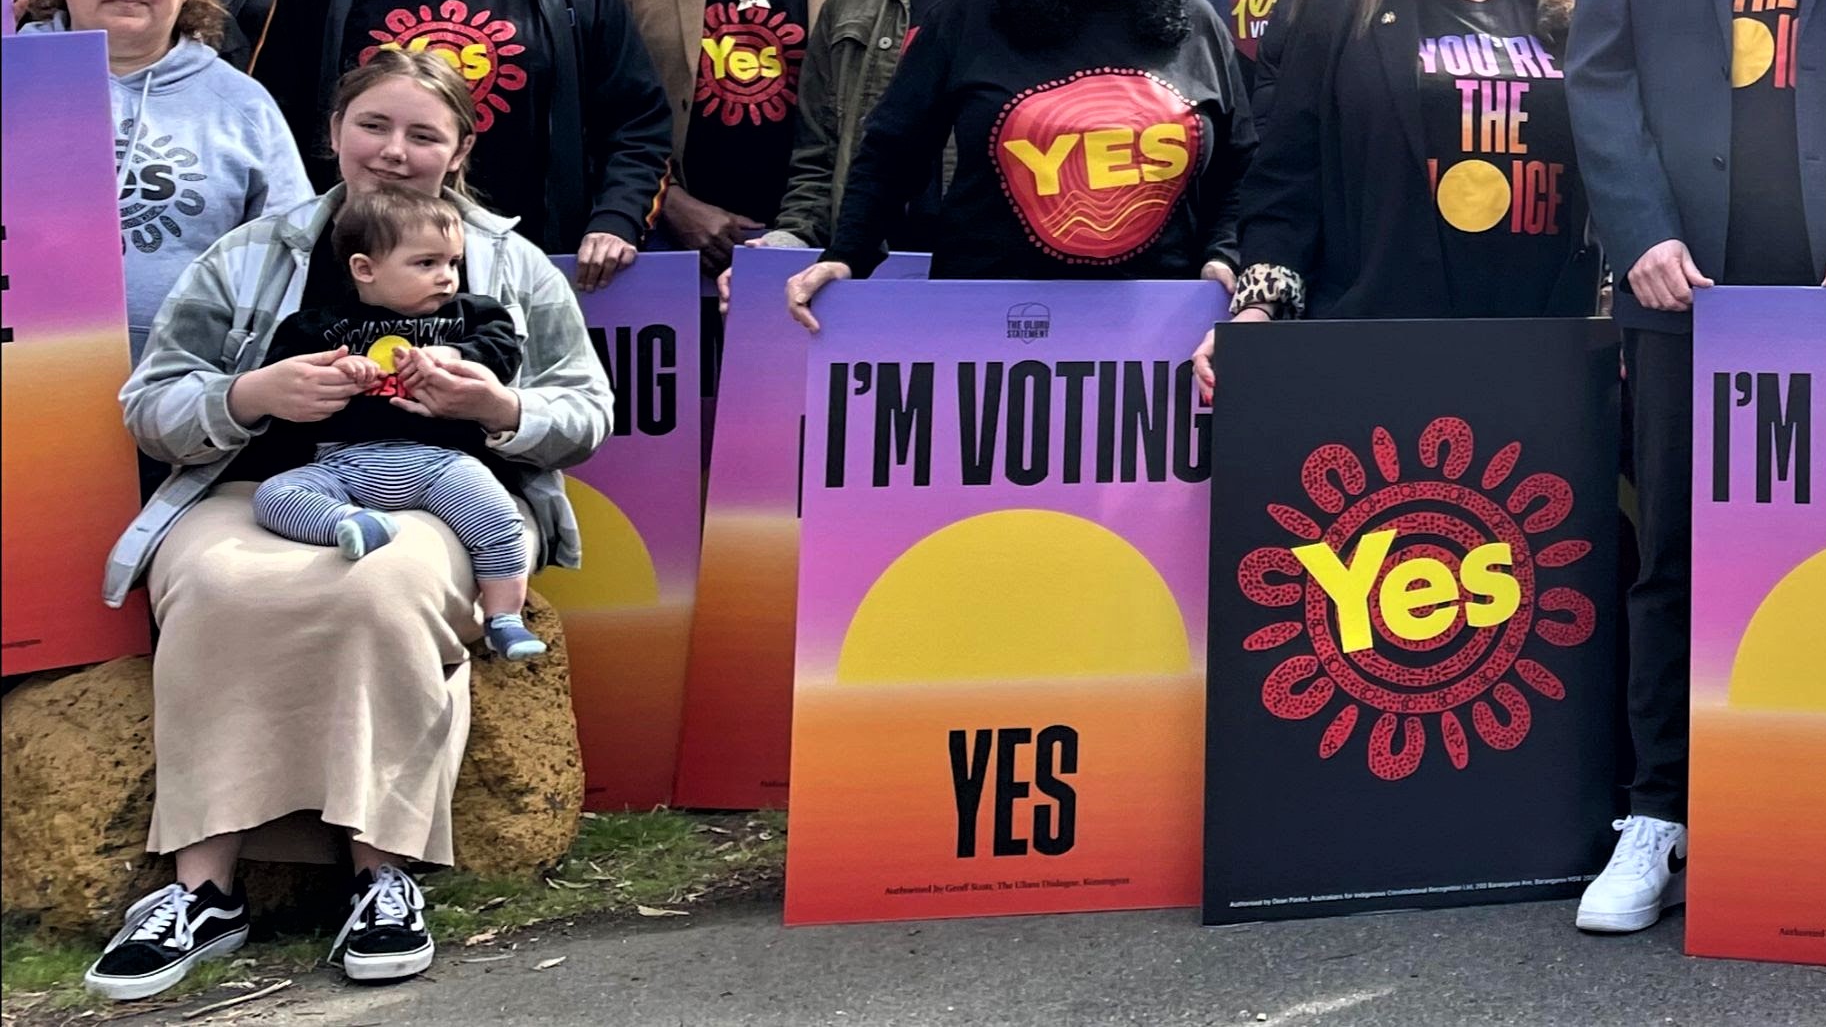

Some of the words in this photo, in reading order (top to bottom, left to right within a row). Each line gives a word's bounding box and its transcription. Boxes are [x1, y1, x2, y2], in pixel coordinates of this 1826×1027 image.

[701, 35, 783, 80] Yes
[1419, 33, 1565, 79] YOU'RE
[1003, 123, 1190, 196] YES
[1455, 79, 1530, 154] THE
[825, 361, 935, 489] I'M
[957, 360, 1213, 489] VOTING
[1712, 371, 1812, 505] I'M
[1292, 529, 1521, 654] Yes
[948, 724, 1079, 859] YES
